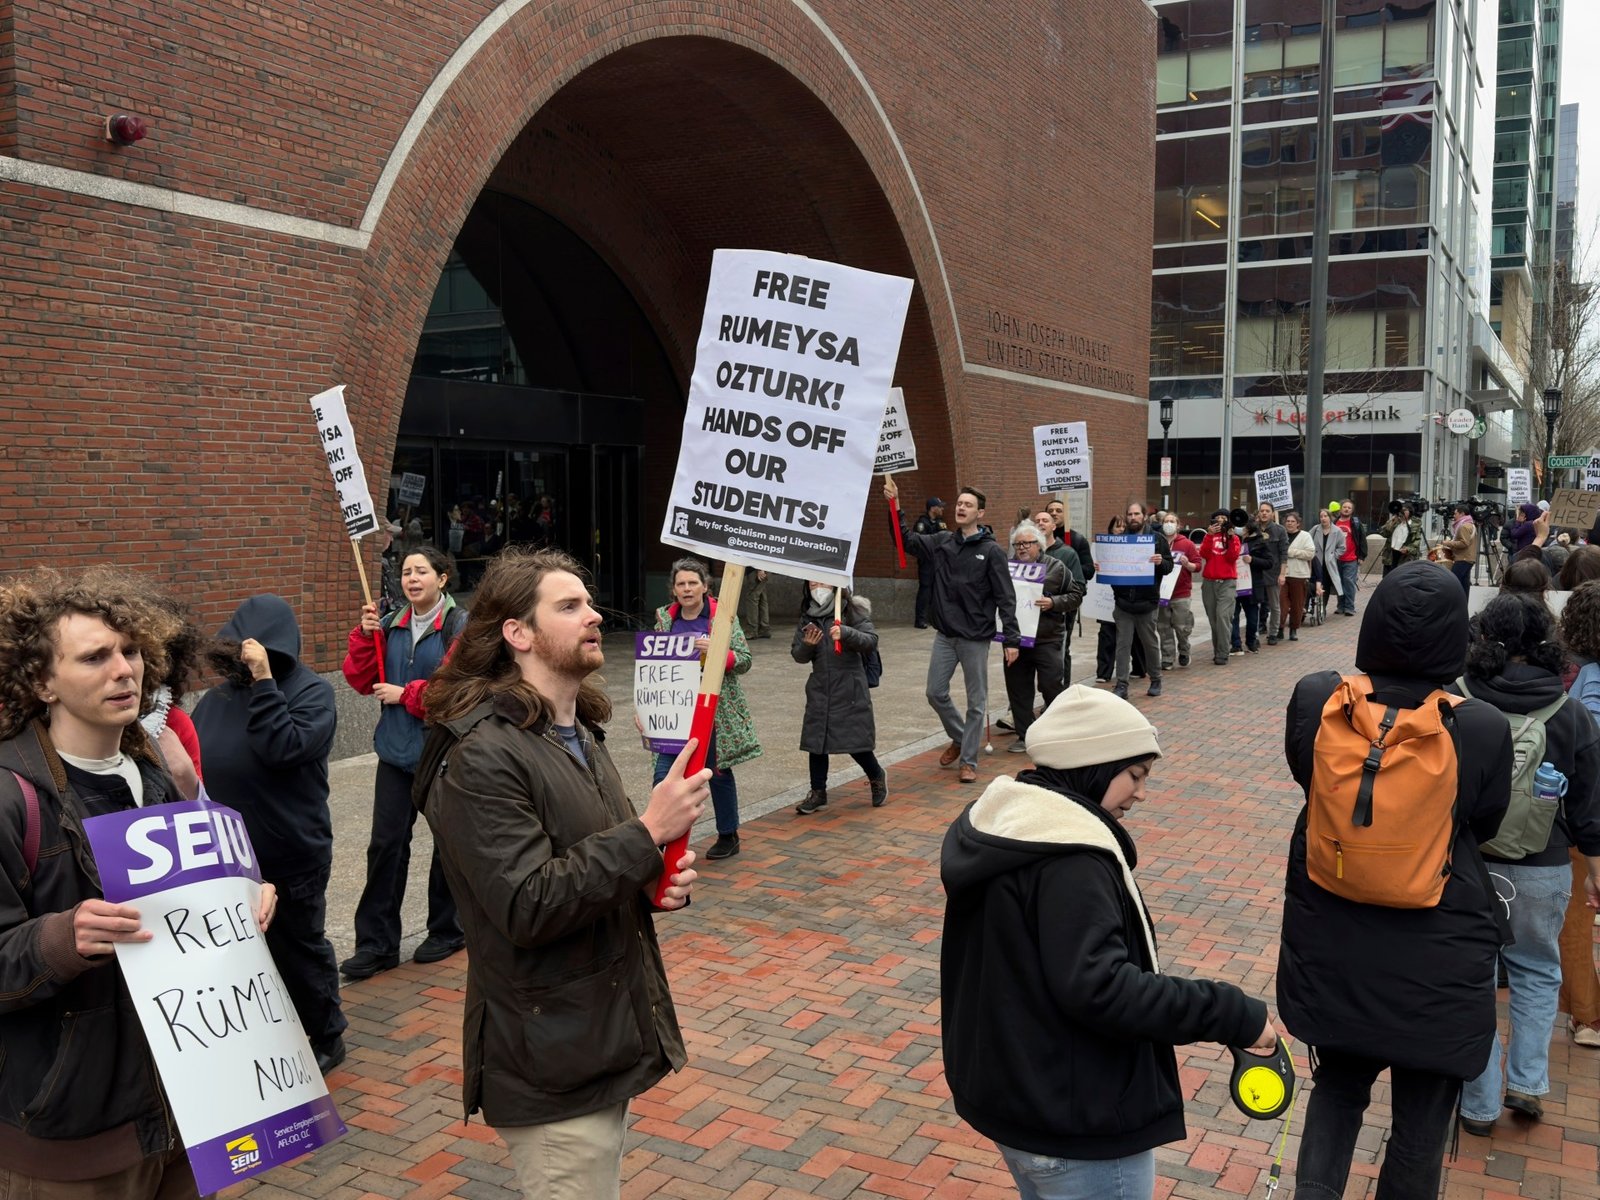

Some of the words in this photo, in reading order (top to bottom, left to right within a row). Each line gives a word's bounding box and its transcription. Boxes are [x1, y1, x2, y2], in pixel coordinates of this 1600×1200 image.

[753, 270, 830, 309] FREE
[719, 315, 860, 366] RUMEYSA
[988, 310, 1020, 338] JOHN
[1027, 322, 1065, 350] JOSEPH
[1070, 334, 1112, 362] MOAKLEY
[987, 340, 1032, 368] UNITED
[1039, 352, 1072, 378] STATES
[1078, 362, 1134, 390] COURTHOUSE
[716, 361, 845, 411] OZTURK!
[1276, 409, 1346, 424] Leaer
[702, 407, 782, 442] HANDS
[786, 421, 846, 453] OFF
[886, 430, 902, 440] OFF
[1050, 427, 1068, 435] FREE
[1042, 437, 1079, 446] RUMEYSA
[1044, 447, 1078, 456] OZTURK!
[726, 449, 787, 483] OUR
[1044, 460, 1066, 468] HANDS
[335, 466, 352, 483] OFF
[1046, 476, 1082, 484] STUDENTS!
[1258, 468, 1286, 481] RELEASE
[1260, 492, 1278, 500] HANDS
[1278, 488, 1289, 496] OFF
[1556, 490, 1600, 509] FREE
[692, 480, 829, 530] STUDENTS!
[1554, 508, 1589, 525] HER
[696, 518, 711, 532] Party
[712, 522, 722, 531] for
[724, 524, 767, 540] Socialism
[768, 534, 787, 544] and
[789, 537, 838, 554] Liberation
[727, 537, 785, 554] @bostonpsl
[640, 635, 696, 656] SEIU
[639, 664, 684, 684] FREE
[636, 688, 694, 707] RÜMEYSA
[648, 713, 679, 731] NOW
[125, 810, 254, 886] SEIU
[164, 902, 256, 954] RELE
[274, 1126, 294, 1138] Service
[231, 1150, 260, 1170] SEIU
